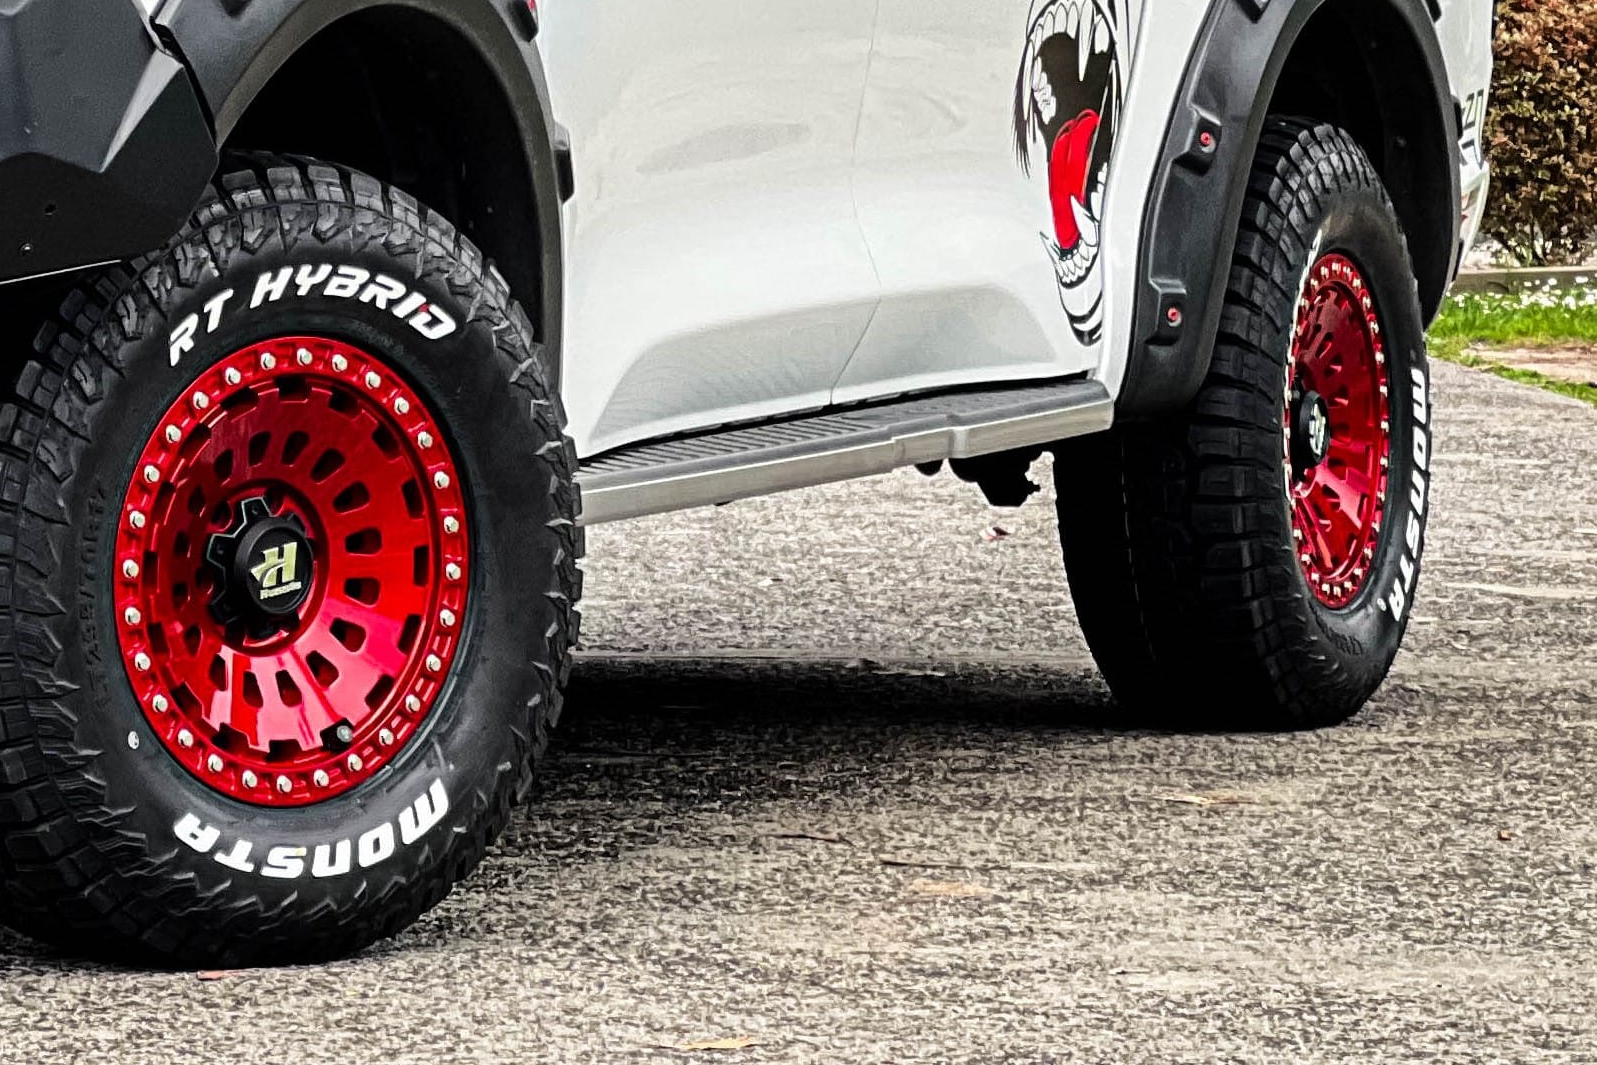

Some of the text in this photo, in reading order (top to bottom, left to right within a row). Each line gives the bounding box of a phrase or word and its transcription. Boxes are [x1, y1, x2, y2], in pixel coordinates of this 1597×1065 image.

[168, 264, 458, 367] RT HYBRID
[1385, 367, 1429, 623] MONSTA
[172, 777, 451, 879] MONSTA
